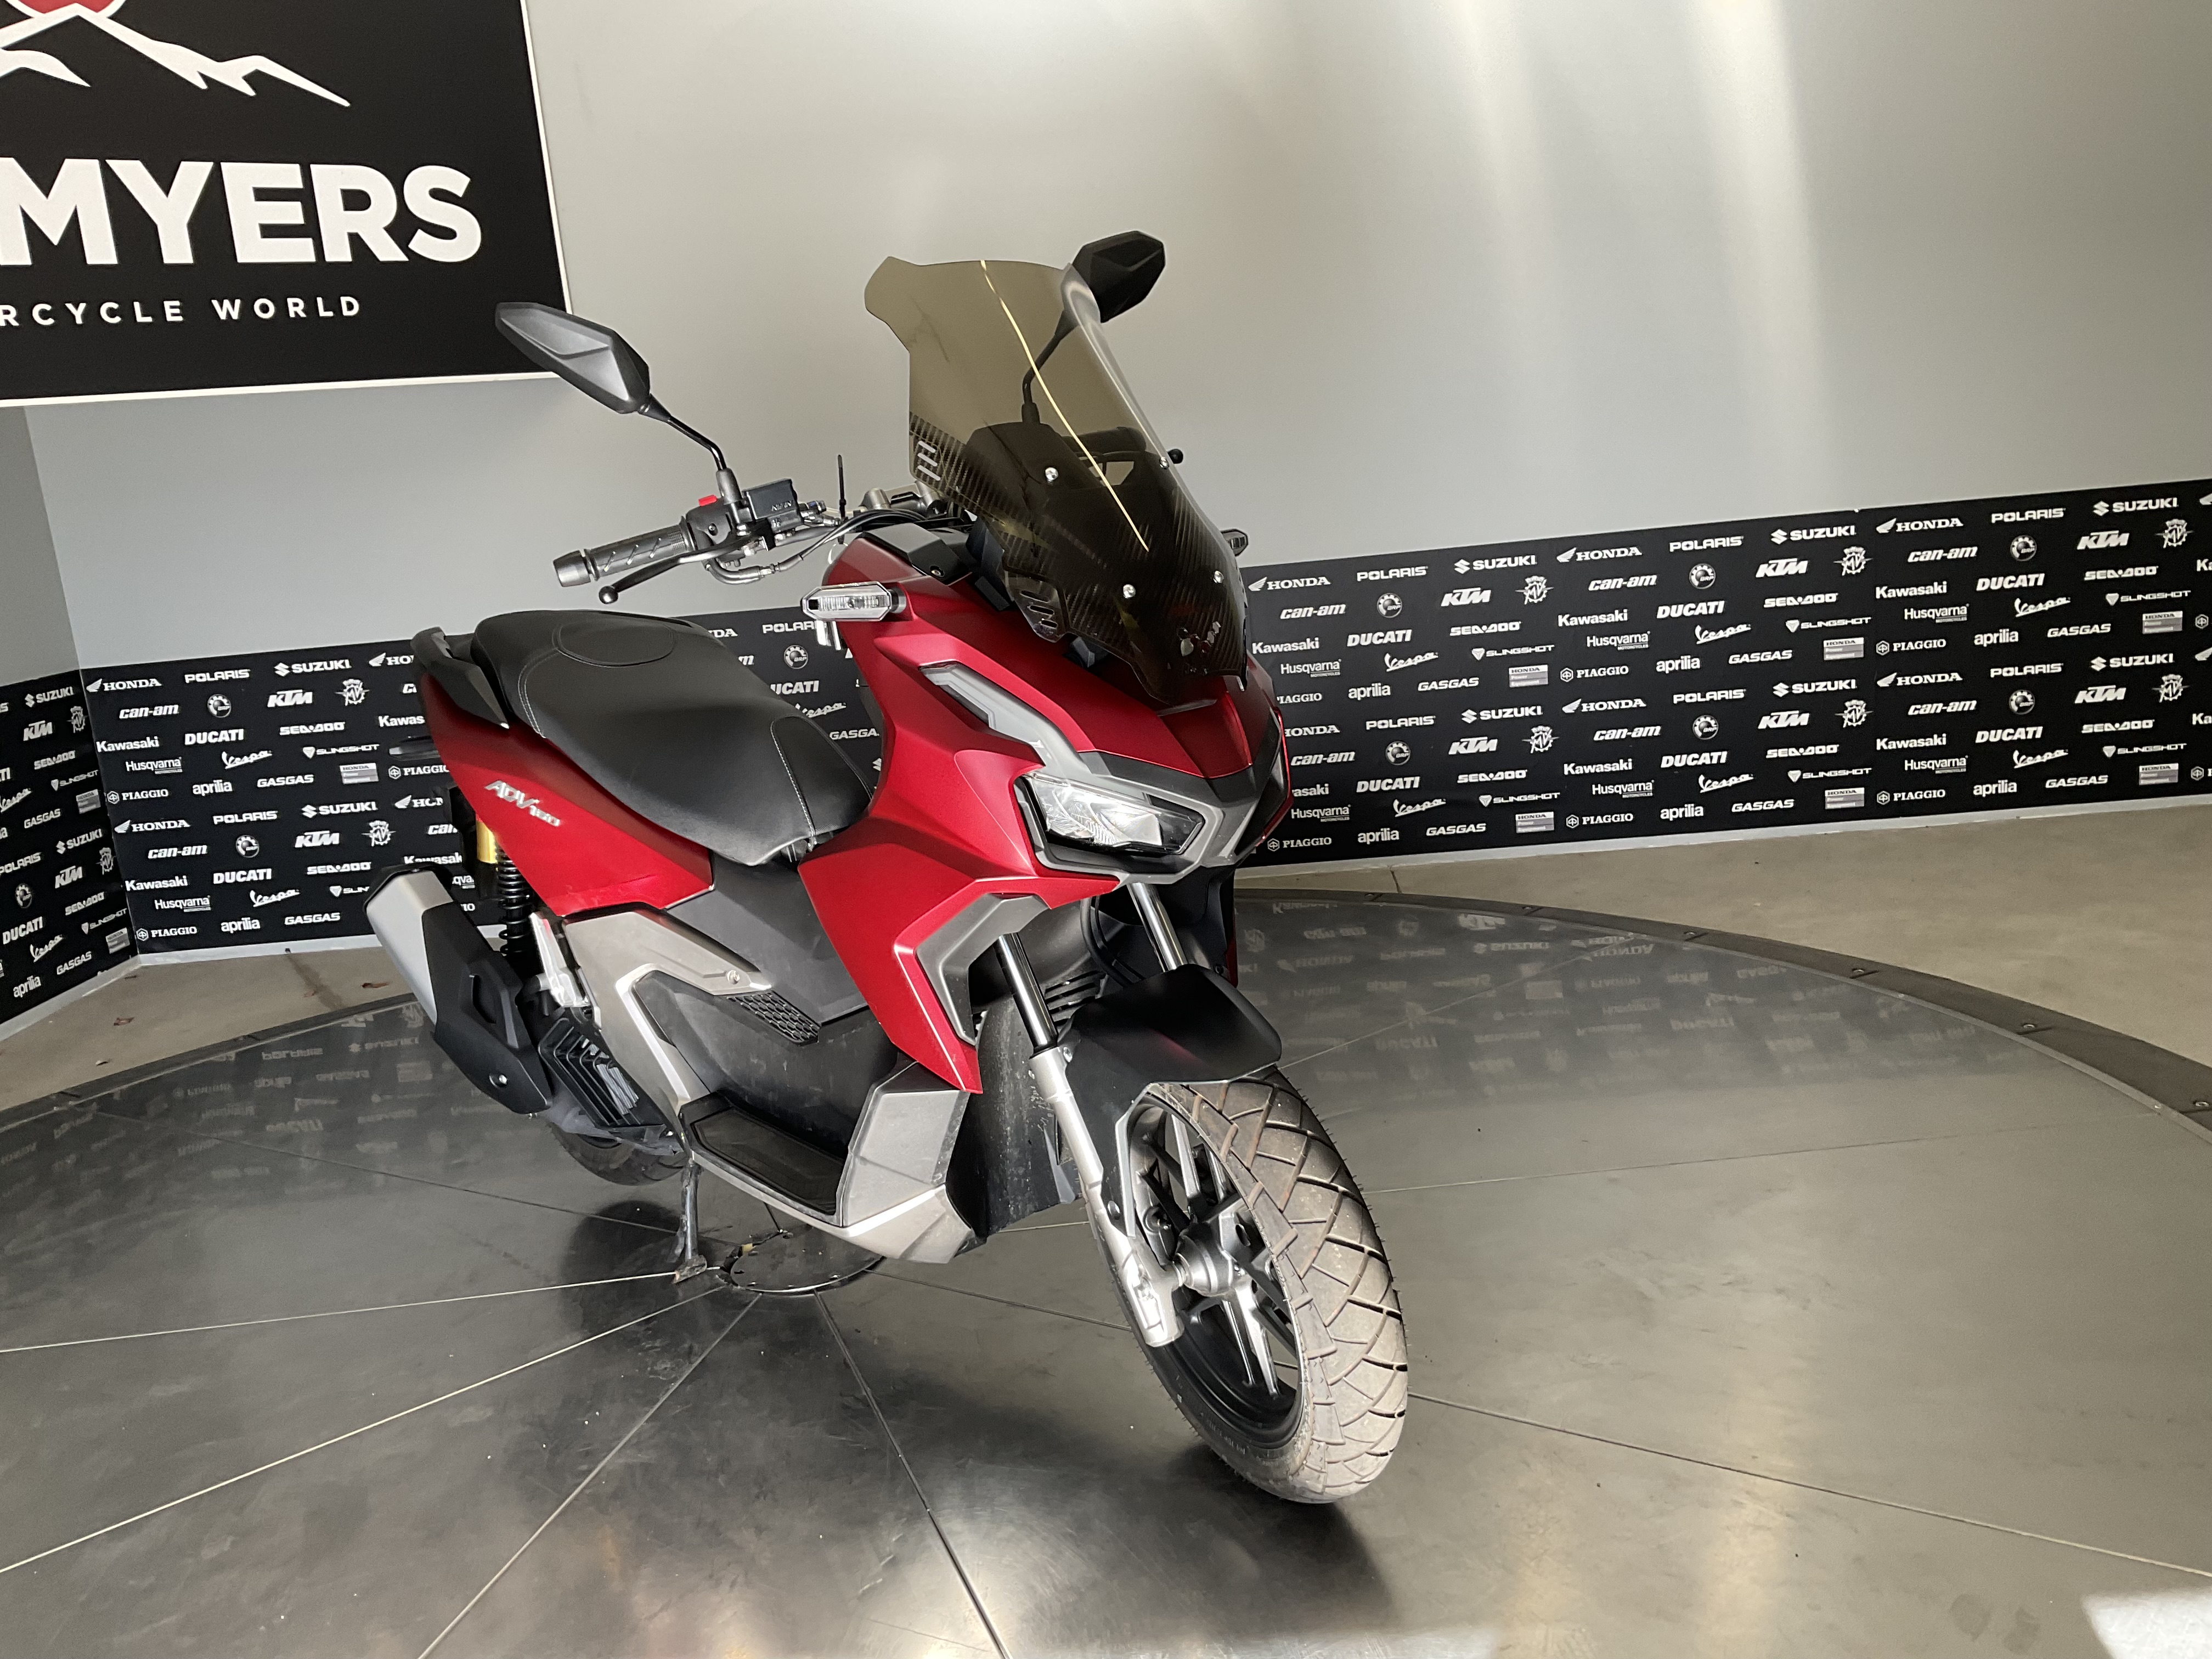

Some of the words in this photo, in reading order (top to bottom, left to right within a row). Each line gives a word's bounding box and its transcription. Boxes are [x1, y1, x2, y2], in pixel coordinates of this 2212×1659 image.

[0, 157, 481, 265] MYERS
[212, 297, 359, 319] WORLD
[2113, 498, 2179, 512] SUZUKI
[1991, 508, 2066, 523] POLARIS
[1895, 517, 1964, 532] HONDA
[1790, 525, 1857, 541] SUZUKI
[2077, 531, 2129, 550] KTM
[1669, 536, 1743, 552] POLARIS
[1576, 546, 1643, 561] HONDA
[1472, 555, 1537, 571] SUZUKI
[1756, 558, 1808, 578] KTM
[1357, 566, 1428, 582] POLARIS
[1267, 575, 1331, 591] HONDA
[1976, 573, 2045, 591] DUCATI
[1441, 588, 1491, 606] KTM
[1876, 581, 1946, 599] Kawasaki
[2120, 590, 2191, 602] SLINGSHOT
[1657, 601, 1725, 618] DUCATI
[1904, 605, 1968, 620] Husqvarna
[2015, 597, 2070, 617] Vespa
[1558, 609, 1628, 627] Kawasaki
[1801, 617, 1871, 629] SLINGSHOT
[763, 620, 816, 634] POLAR
[1695, 624, 1751, 644] Vespa
[2047, 623, 2111, 637] GASGAS
[1347, 629, 1412, 647] DUCATI
[1586, 633, 1649, 647] Husqvarna
[1893, 639, 1946, 652] PIAGGIO
[1974, 629, 2018, 647] aprilia
[1252, 637, 1320, 655] Kawasaki
[1486, 644, 1555, 657] SLINGSHOT
[1384, 652, 1438, 672] Vespa
[1656, 655, 1700, 674] aprilia
[1729, 650, 1792, 664] GASGAS
[2110, 653, 2174, 668] SUZUKI
[291, 659, 352, 673] SUZUKI
[1280, 661, 1340, 675] Husqvarna
[1576, 665, 1629, 679] PIAGGIO
[1990, 663, 2063, 678] POLARIS
[184, 669, 251, 683] POLARIS
[1896, 672, 1963, 686] HONDA
[103, 678, 162, 691] HONDA
[770, 680, 819, 695] UCATI
[1348, 682, 1391, 700] aprilia
[1418, 678, 1479, 691] GASGAS
[1792, 679, 1858, 694] SUZUKI
[36, 686, 74, 703] SUZUKI
[267, 690, 313, 707] KTM
[1277, 693, 1322, 704] IAGGIO
[1673, 689, 1746, 704] POLARIS
[2075, 685, 2126, 703] KTM
[1581, 698, 1647, 712] HONDA
[1479, 706, 1543, 720] SUZUKI
[1758, 710, 1810, 729] KTM
[379, 715, 425, 727] Kawas
[1366, 716, 1436, 730] POLARIS
[24, 720, 52, 741] KTM
[185, 729, 244, 745] DUCATI
[830, 729, 879, 740] GASGA
[1976, 726, 2043, 743] DUCATI
[96, 736, 159, 752] Kawasaki
[316, 743, 380, 755] SLINGSHOT
[1448, 737, 1498, 754] KTM
[1877, 733, 1946, 750] Kawasaki
[2117, 743, 2187, 754] SLINGSHOT
[126, 759, 181, 771] Husqvarna
[222, 751, 272, 769] Vespa
[1564, 758, 1632, 775] Kawasaki
[1661, 751, 1728, 768] DUCATI
[1904, 757, 1967, 771] Husqvarna
[2013, 749, 2068, 769] Vespa
[257, 775, 314, 787] GASGAS
[1802, 768, 1872, 779] SLINGSHOT
[193, 780, 233, 796] aprilia
[1357, 776, 1420, 792] DUCATI
[1592, 781, 1653, 795] Husqvarna
[1699, 774, 1754, 793] Vespa
[1973, 780, 2017, 797] aprilia
[2045, 775, 2108, 788] GASGAS
[121, 789, 169, 800] PIAGGIO
[1292, 783, 1329, 797] asaki
[1893, 789, 1946, 802] PIAGGIO
[1493, 792, 1560, 804] SLINGSHOT
[1732, 799, 1795, 812] GASGAS
[318, 801, 378, 815] SUZUKI
[1291, 806, 1350, 819] Husqvarna
[1393, 799, 1446, 817] Vespa
[1661, 804, 1703, 821] aprilia
[24, 809, 60, 828] GASGAS
[213, 811, 278, 824] POLARIS
[1582, 813, 1634, 825] PIAGGIO
[131, 819, 191, 832] HONDA
[1426, 823, 1486, 836] GASGAS
[66, 828, 103, 854] SUZUKI
[295, 831, 340, 848] KTM
[1282, 837, 1332, 848] PIAGGIO
[1358, 828, 1399, 844] aprilia
[55, 866, 82, 888] KTM
[125, 875, 189, 891] Kawasaki
[213, 868, 272, 884] DUCATI
[154, 897, 210, 910] Husqvarna
[250, 889, 300, 907] Vespa
[221, 917, 261, 933] aprilia
[284, 912, 340, 925] GASGAS
[3, 916, 43, 944] DUCATI
[150, 926, 198, 938] PIAGGIO
[57, 951, 92, 974] GASGAS
[13, 975, 41, 997] aprilia
